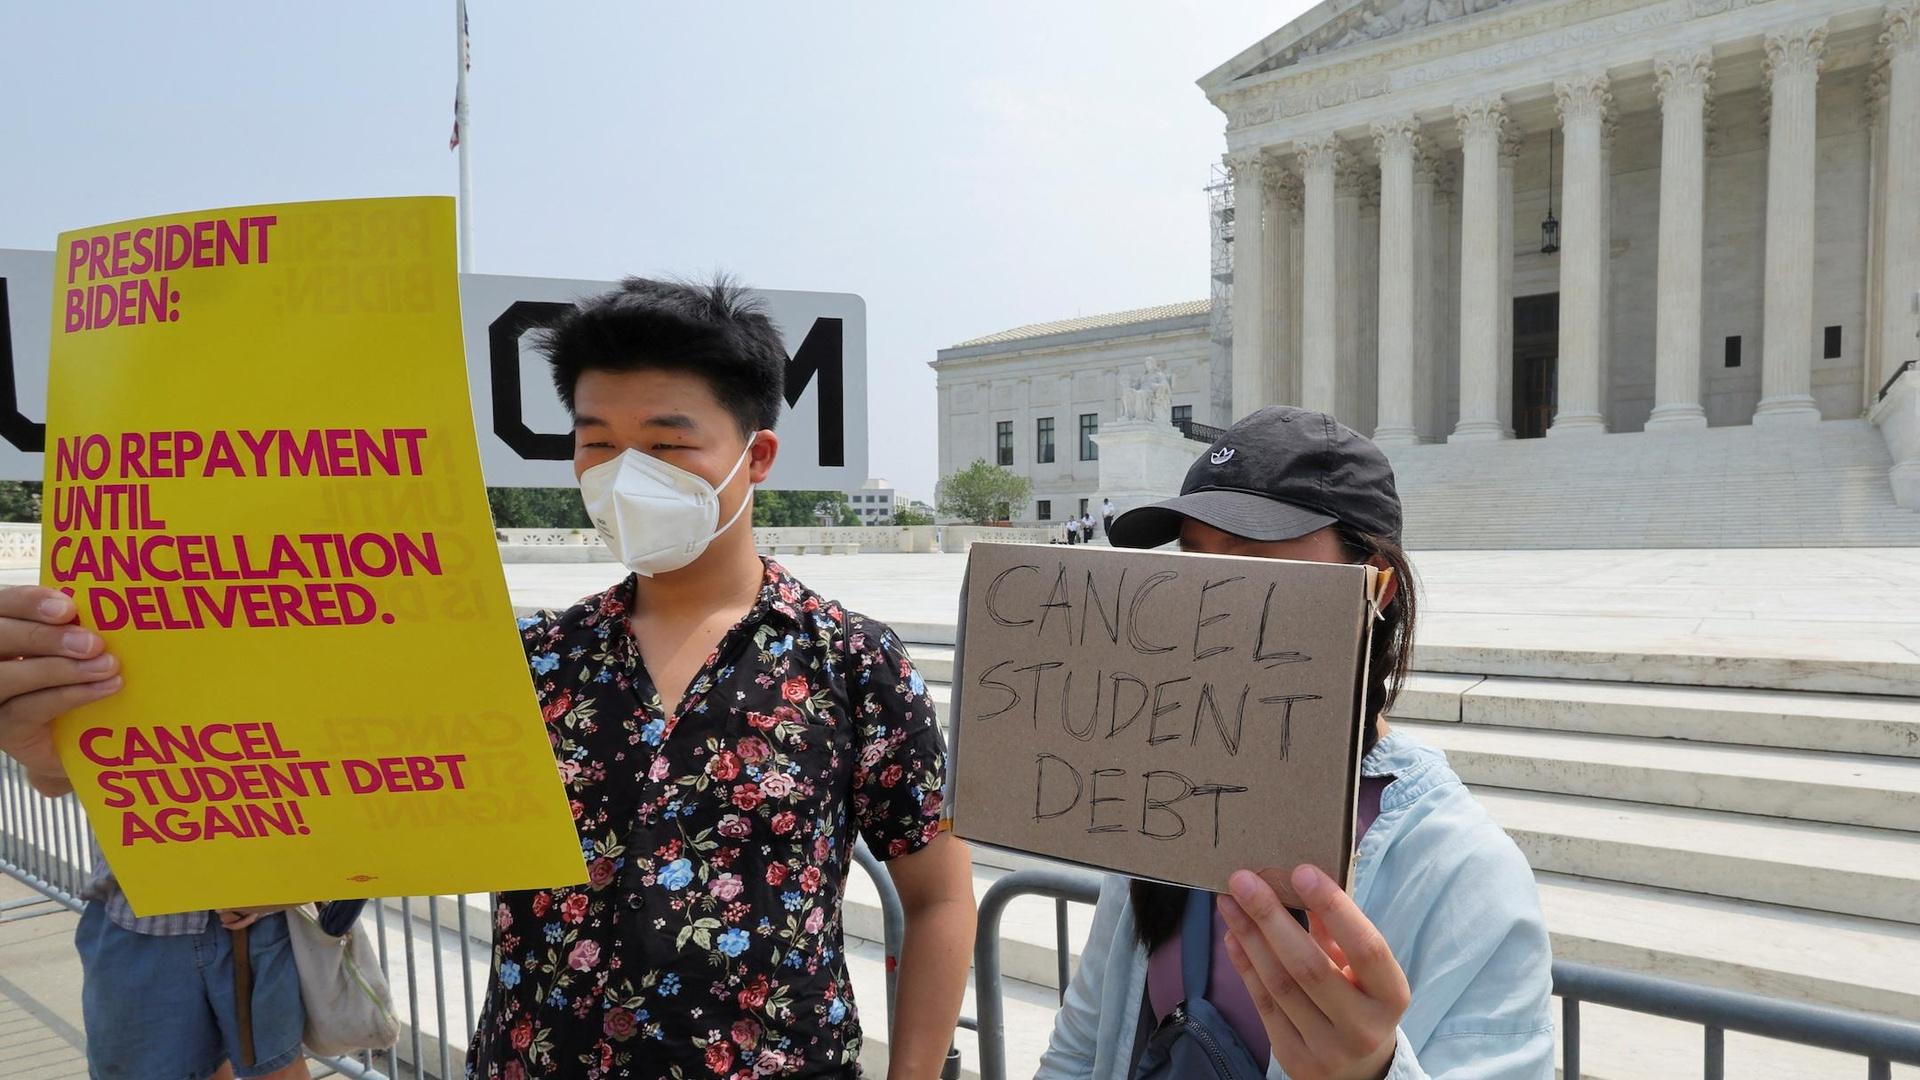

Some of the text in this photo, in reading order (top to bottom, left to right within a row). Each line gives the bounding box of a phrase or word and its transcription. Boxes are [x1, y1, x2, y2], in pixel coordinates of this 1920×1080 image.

[1472, 38, 1545, 71] JUSTICE
[1552, 18, 1621, 49] UNDER
[68, 215, 277, 283] PRESIDENT
[65, 277, 180, 333] BIDEN:
[56, 433, 111, 481] NO
[120, 429, 427, 478] REPAYMENT
[53, 484, 165, 531] UNTIL
[50, 532, 441, 581] CANCELLATION
[88, 583, 395, 630] DELIVERED.
[984, 561, 1312, 668] CANCEL
[976, 659, 1323, 762] STUDENT
[78, 722, 299, 767] CANCEL
[96, 761, 330, 808] STUDENT
[341, 754, 466, 794] DEBT
[1032, 752, 1248, 847] DEBT
[121, 800, 311, 846] AGAIN!
